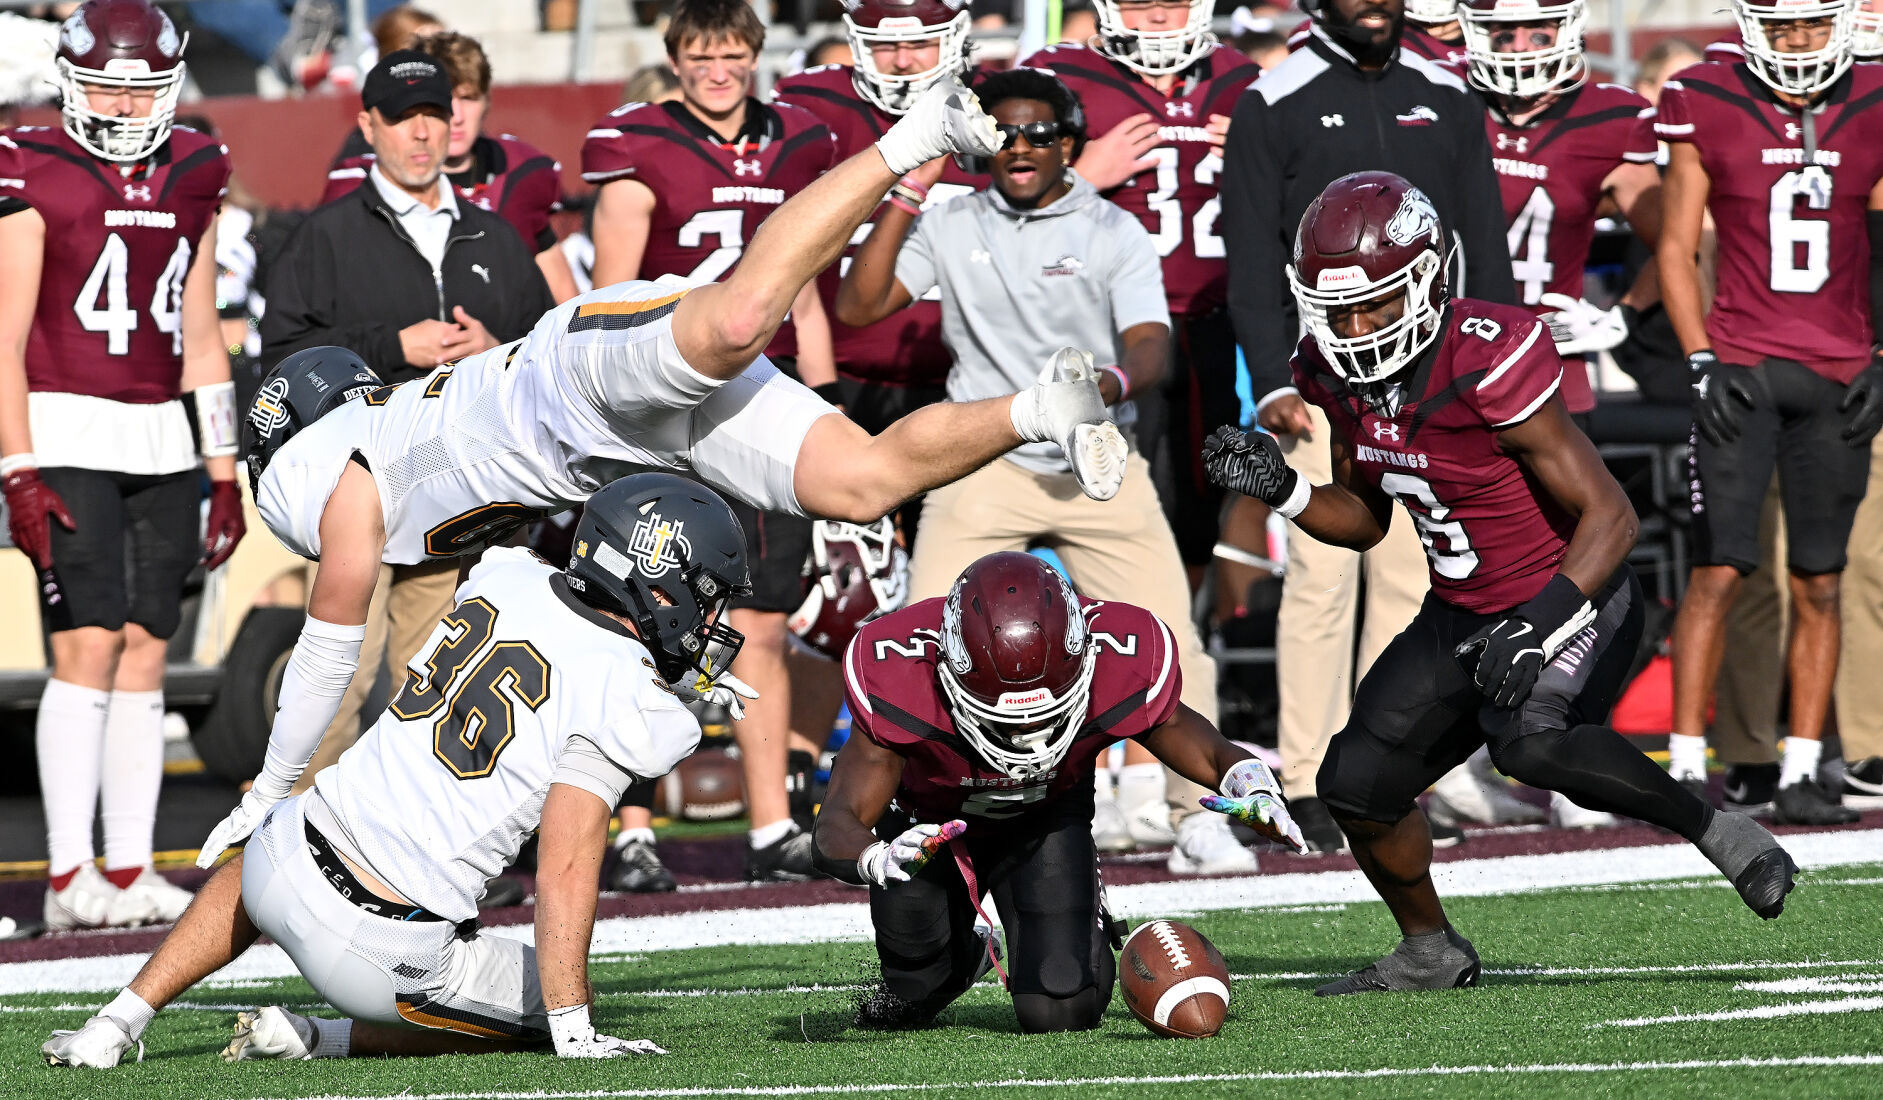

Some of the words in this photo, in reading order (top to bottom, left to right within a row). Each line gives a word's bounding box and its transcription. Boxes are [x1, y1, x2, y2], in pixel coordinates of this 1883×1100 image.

[1761, 148, 1841, 166] MUSTNGS
[1769, 167, 1833, 293] 6
[73, 232, 192, 357] 44
[1460, 316, 1502, 343] 8
[1356, 443, 1429, 470] MUSTANGS
[577, 540, 589, 558] 36
[874, 636, 927, 661] 2
[1089, 631, 1139, 657] 2
[388, 595, 552, 781] 36
[1004, 693, 1046, 705] Riddell
[959, 771, 1058, 787] MUSTGS
